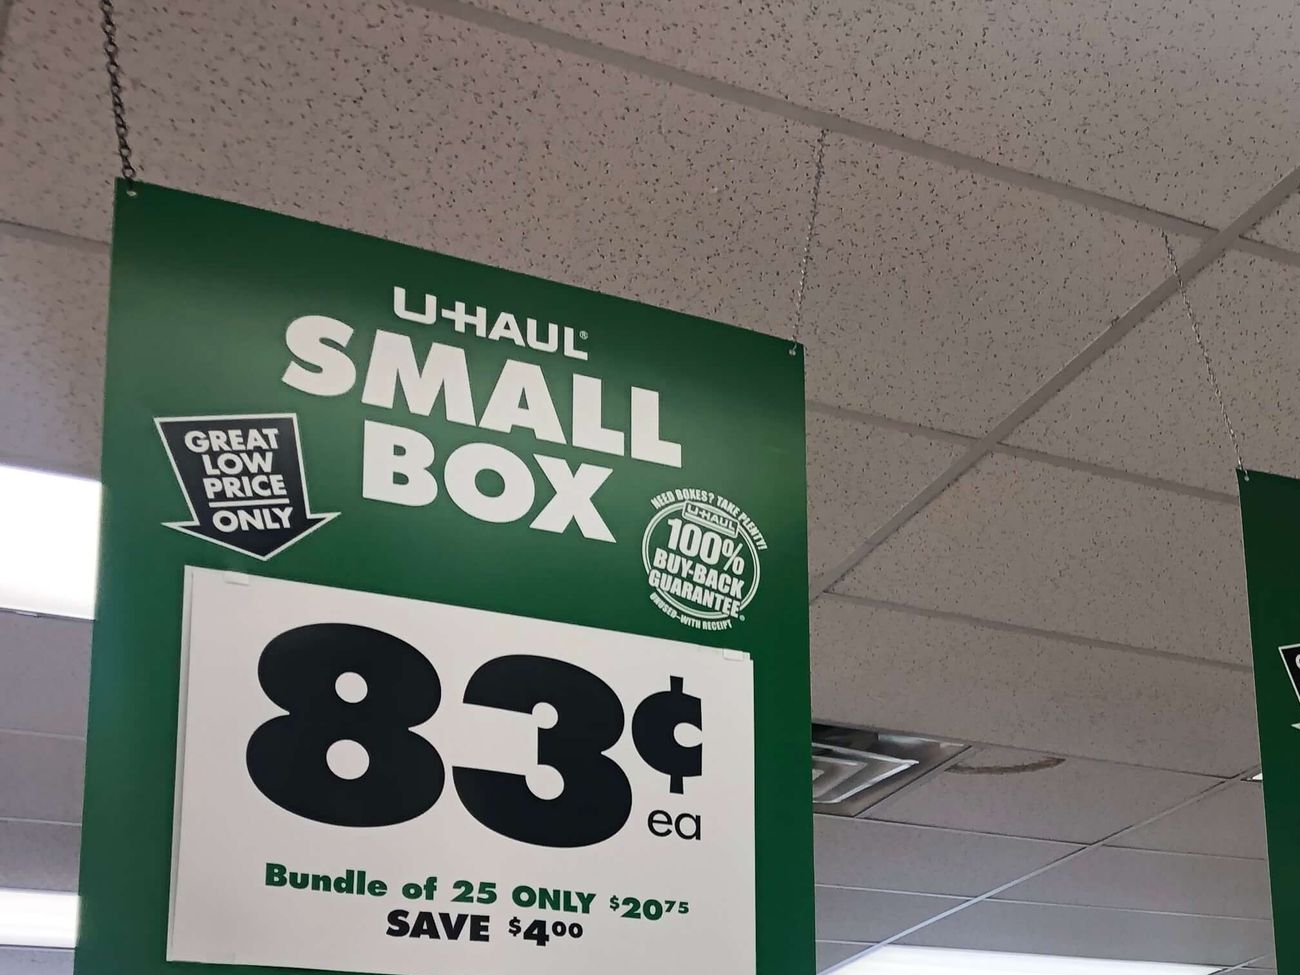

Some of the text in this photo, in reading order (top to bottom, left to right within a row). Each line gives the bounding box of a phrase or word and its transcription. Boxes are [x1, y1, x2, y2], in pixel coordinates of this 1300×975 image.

[282, 315, 682, 468] SMALL
[184, 429, 279, 452] GREAT
[203, 452, 273, 474] LOW
[362, 420, 616, 542] BOX
[204, 474, 287, 499] PRICE
[212, 507, 293, 532] ONLY
[668, 518, 744, 575] 100%
[653, 548, 744, 599] BUY-BACK
[649, 570, 741, 618] GUARANTEE
[647, 808, 701, 840] ea
[265, 863, 387, 897] Bundle
[401, 877, 437, 901] of
[452, 881, 497, 905] 25
[511, 886, 597, 915] ONLY
[386, 910, 492, 942] SAVE
